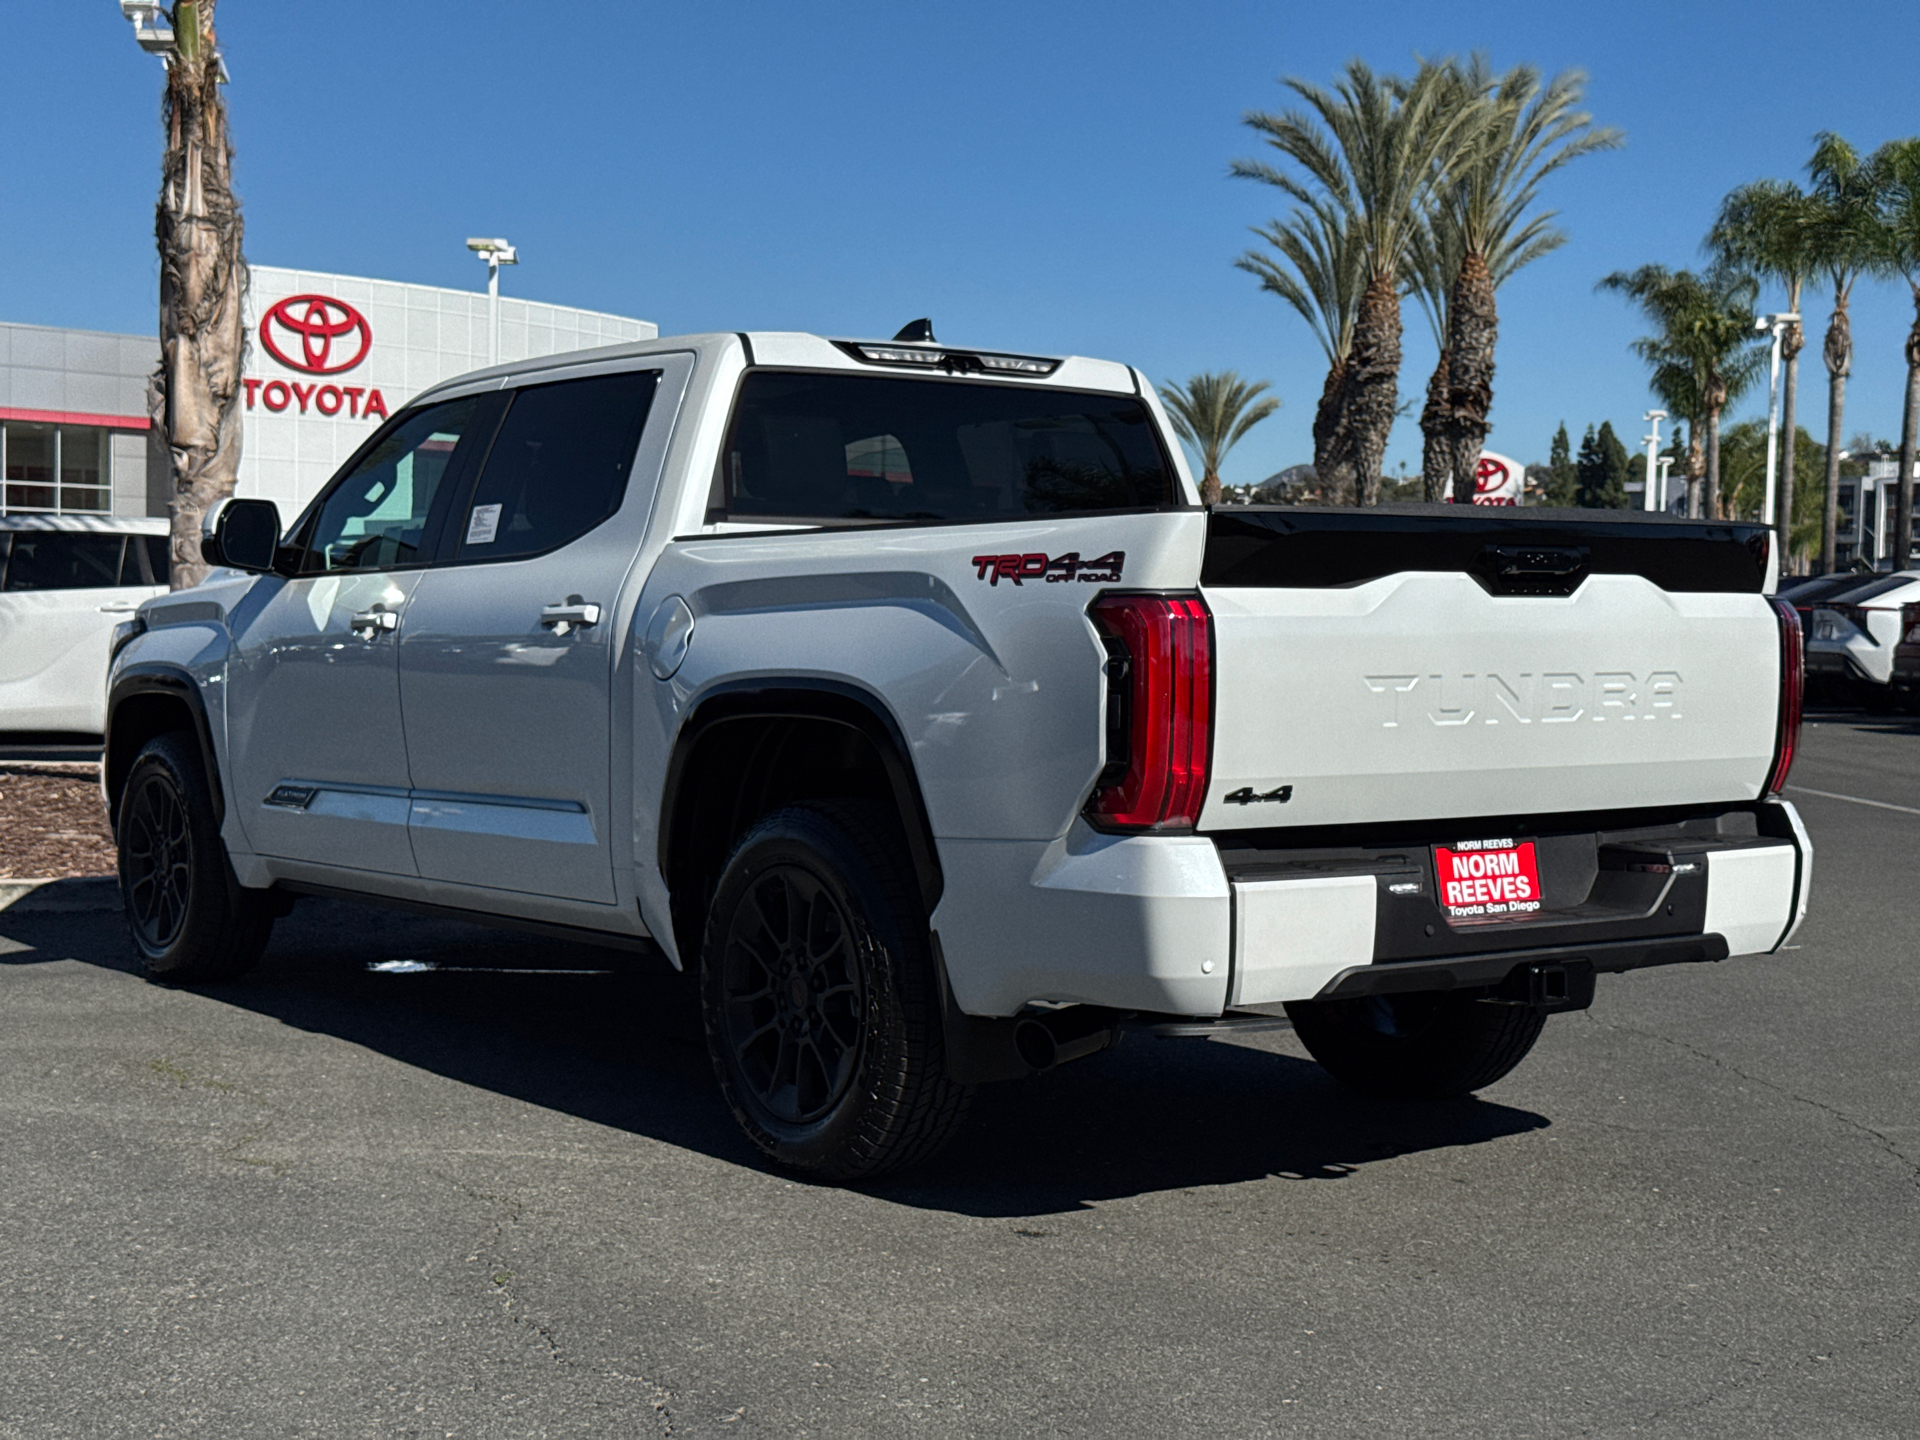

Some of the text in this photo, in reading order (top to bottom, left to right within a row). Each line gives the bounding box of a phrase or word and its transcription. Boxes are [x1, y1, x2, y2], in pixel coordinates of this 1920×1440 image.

[243, 378, 389, 420] TOYOTA
[972, 551, 1126, 586] TRD 4x4
[1046, 573, 1122, 583] OFF ROAD
[1364, 671, 1684, 727] TUNDRA
[1223, 785, 1293, 806] 4x4
[1457, 838, 1513, 851] NORM REEVES
[1452, 853, 1520, 878] NORM
[1446, 876, 1531, 904] REEVES
[1448, 900, 1540, 916] Toyota San Diego
